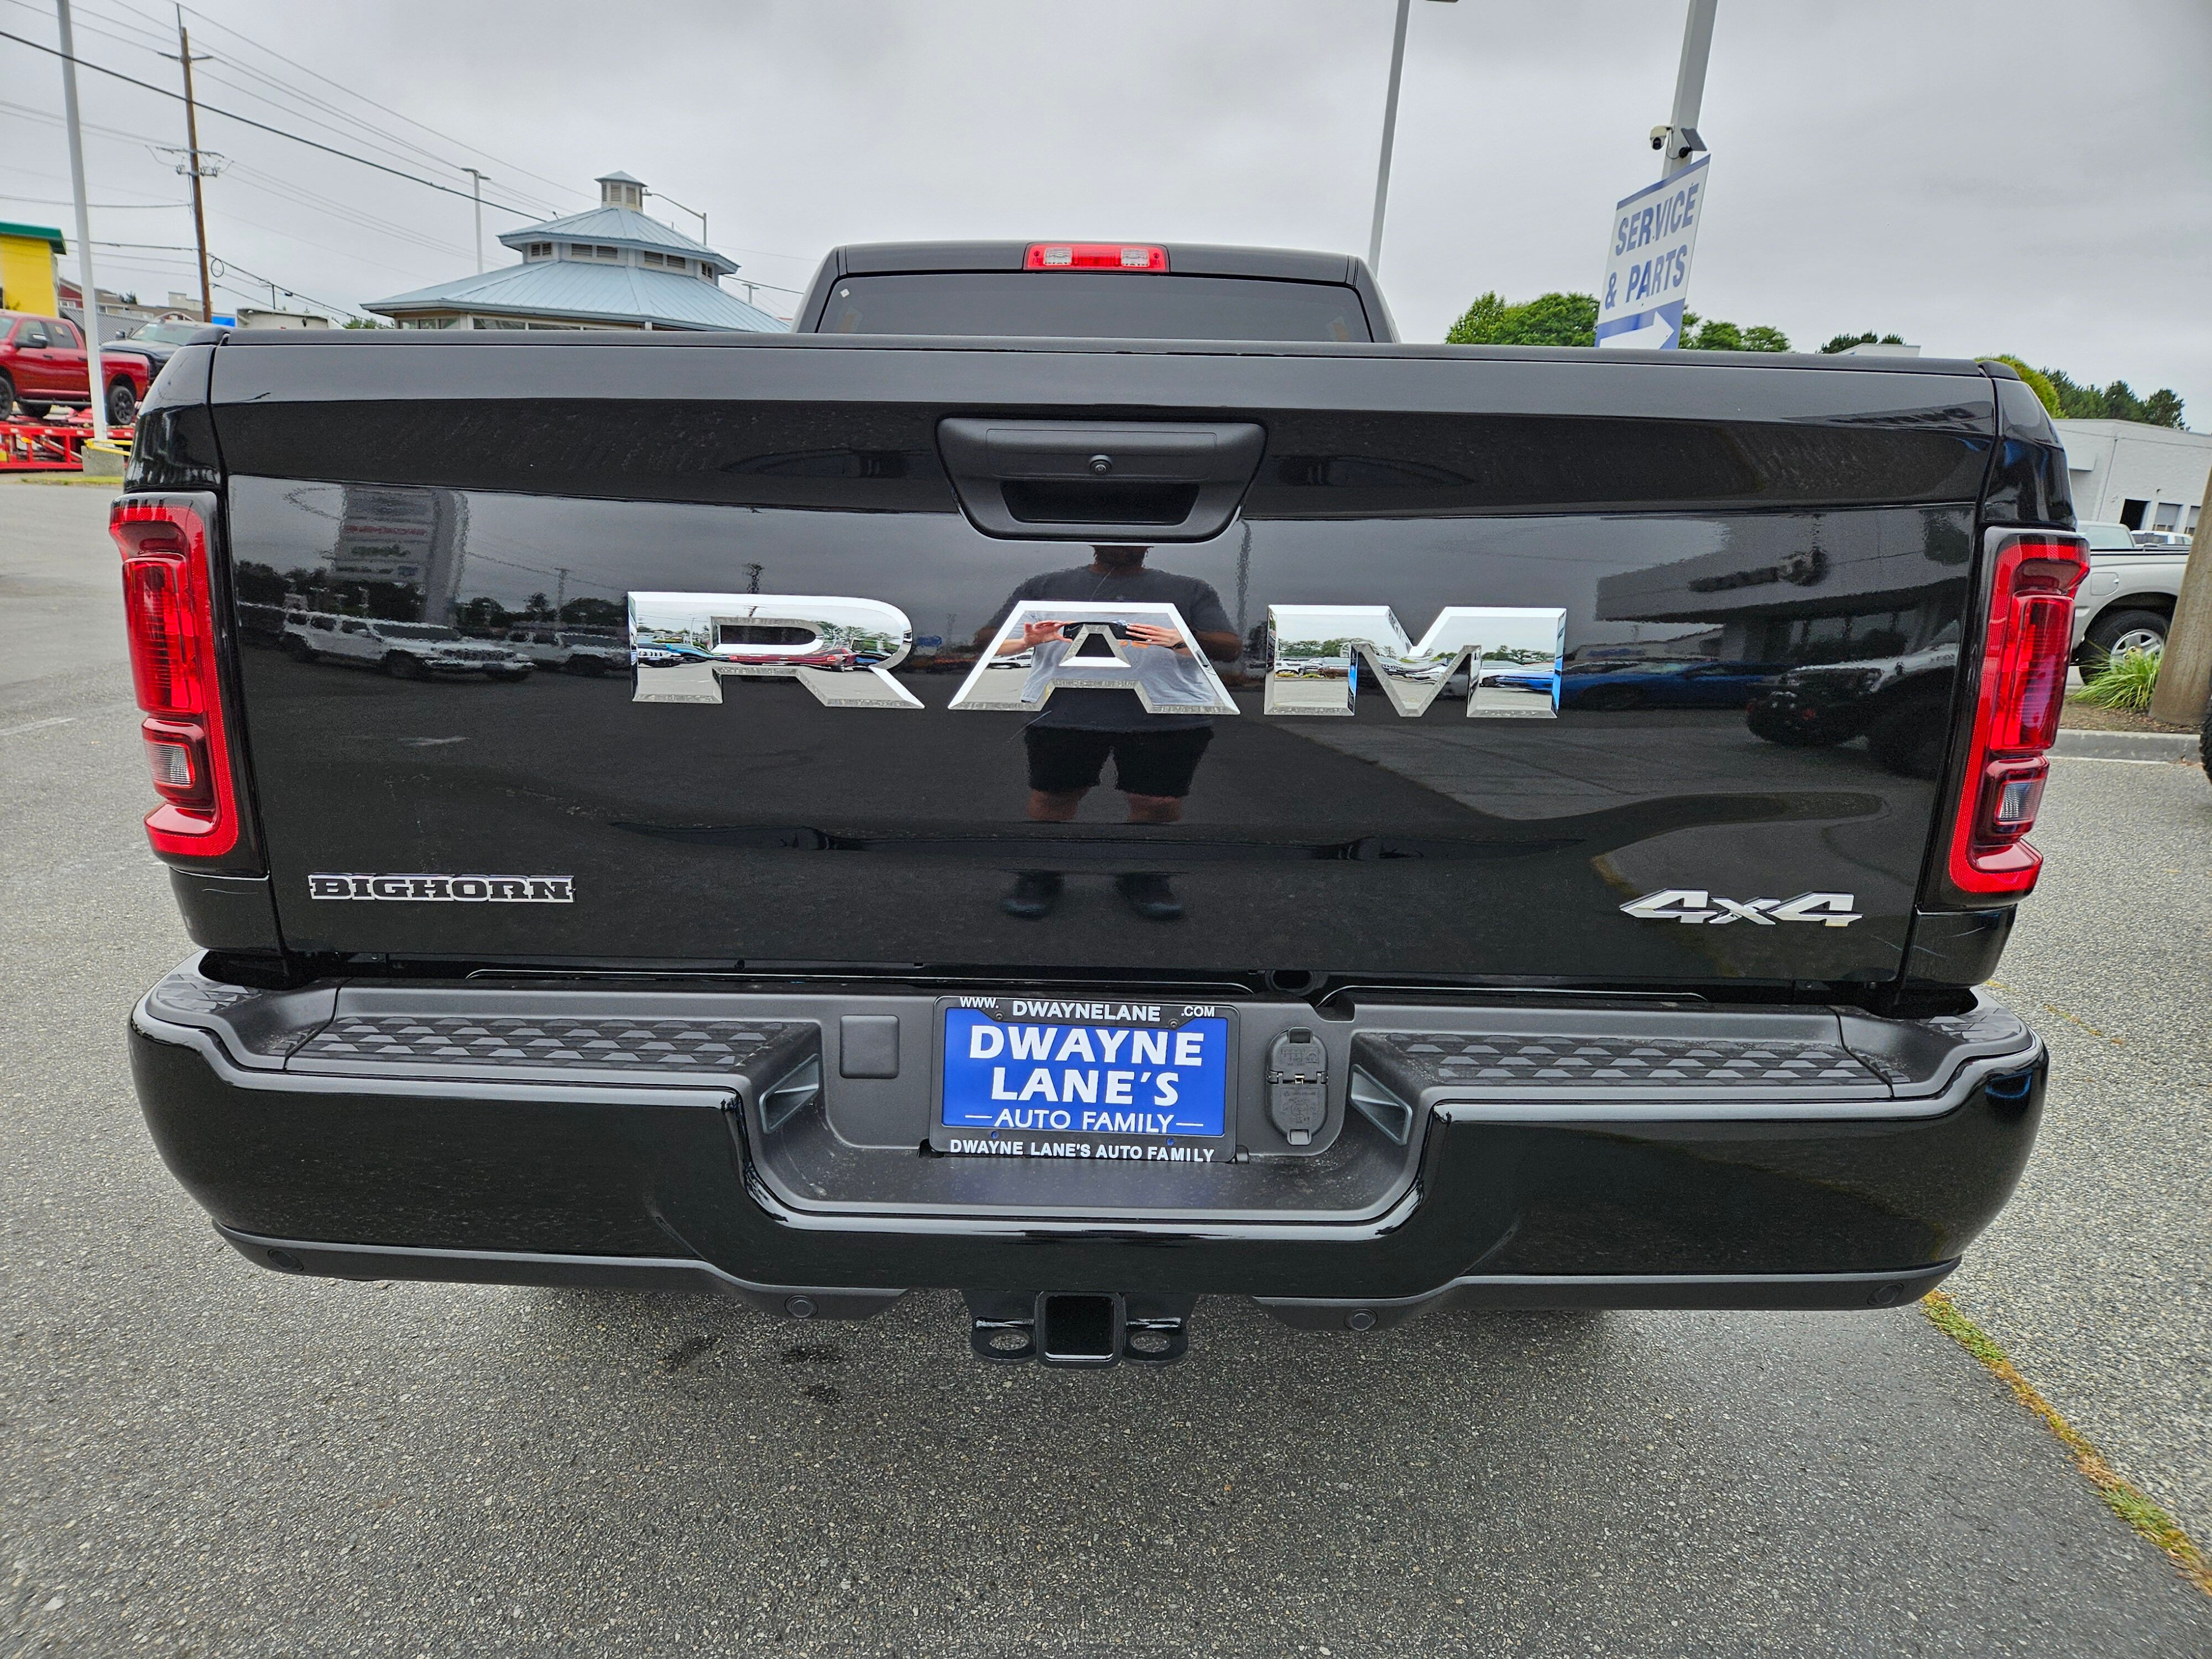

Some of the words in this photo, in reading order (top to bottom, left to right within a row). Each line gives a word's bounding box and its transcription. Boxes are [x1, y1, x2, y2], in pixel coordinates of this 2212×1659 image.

[1615, 182, 1700, 257] SERVICE
[1605, 272, 1618, 310] &
[1626, 244, 1688, 304] PARTS
[627, 591, 1567, 719] RAM
[307, 872, 576, 903] BIGHORN
[959, 997, 999, 1009] WWW.
[1013, 1000, 1161, 1022] DWAYNELANE
[1181, 1005, 1215, 1018] .COM
[969, 1025, 1204, 1067] DWAYNE
[992, 1066, 1179, 1107] LANE'S
[994, 1108, 1072, 1130] AUTO
[1082, 1111, 1175, 1134] FAMILY
[950, 1139, 1024, 1155] DWAYNE
[1031, 1142, 1091, 1158] LANE'S
[1095, 1144, 1143, 1160] AUTO
[1147, 1146, 1215, 1162] FAMILY
